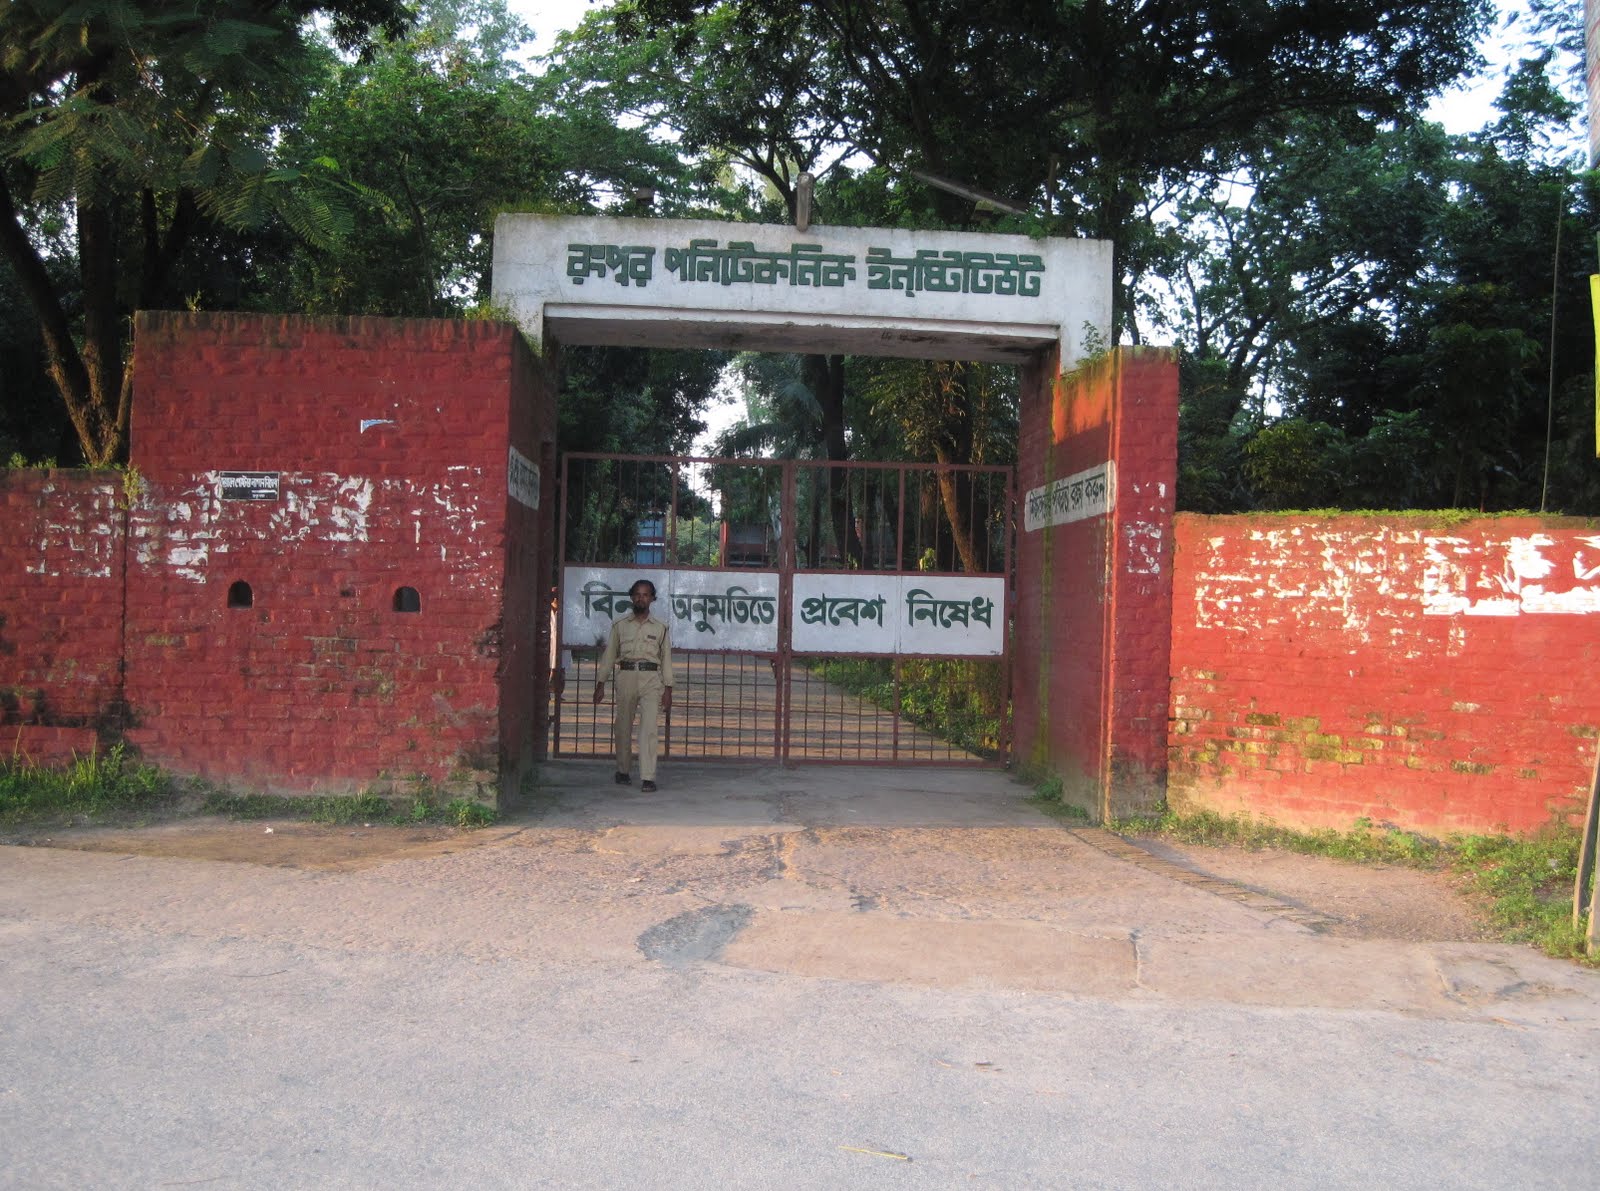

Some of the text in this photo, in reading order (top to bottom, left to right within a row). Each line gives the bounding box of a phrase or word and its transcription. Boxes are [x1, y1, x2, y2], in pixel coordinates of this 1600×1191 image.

[566, 243, 656, 287] রংপুর
[664, 239, 856, 286] পলিটেকনিক
[670, 585, 776, 635] অনুমতিতে
[801, 593, 887, 628] প্রবেশ
[905, 588, 994, 629] নিষেধ
